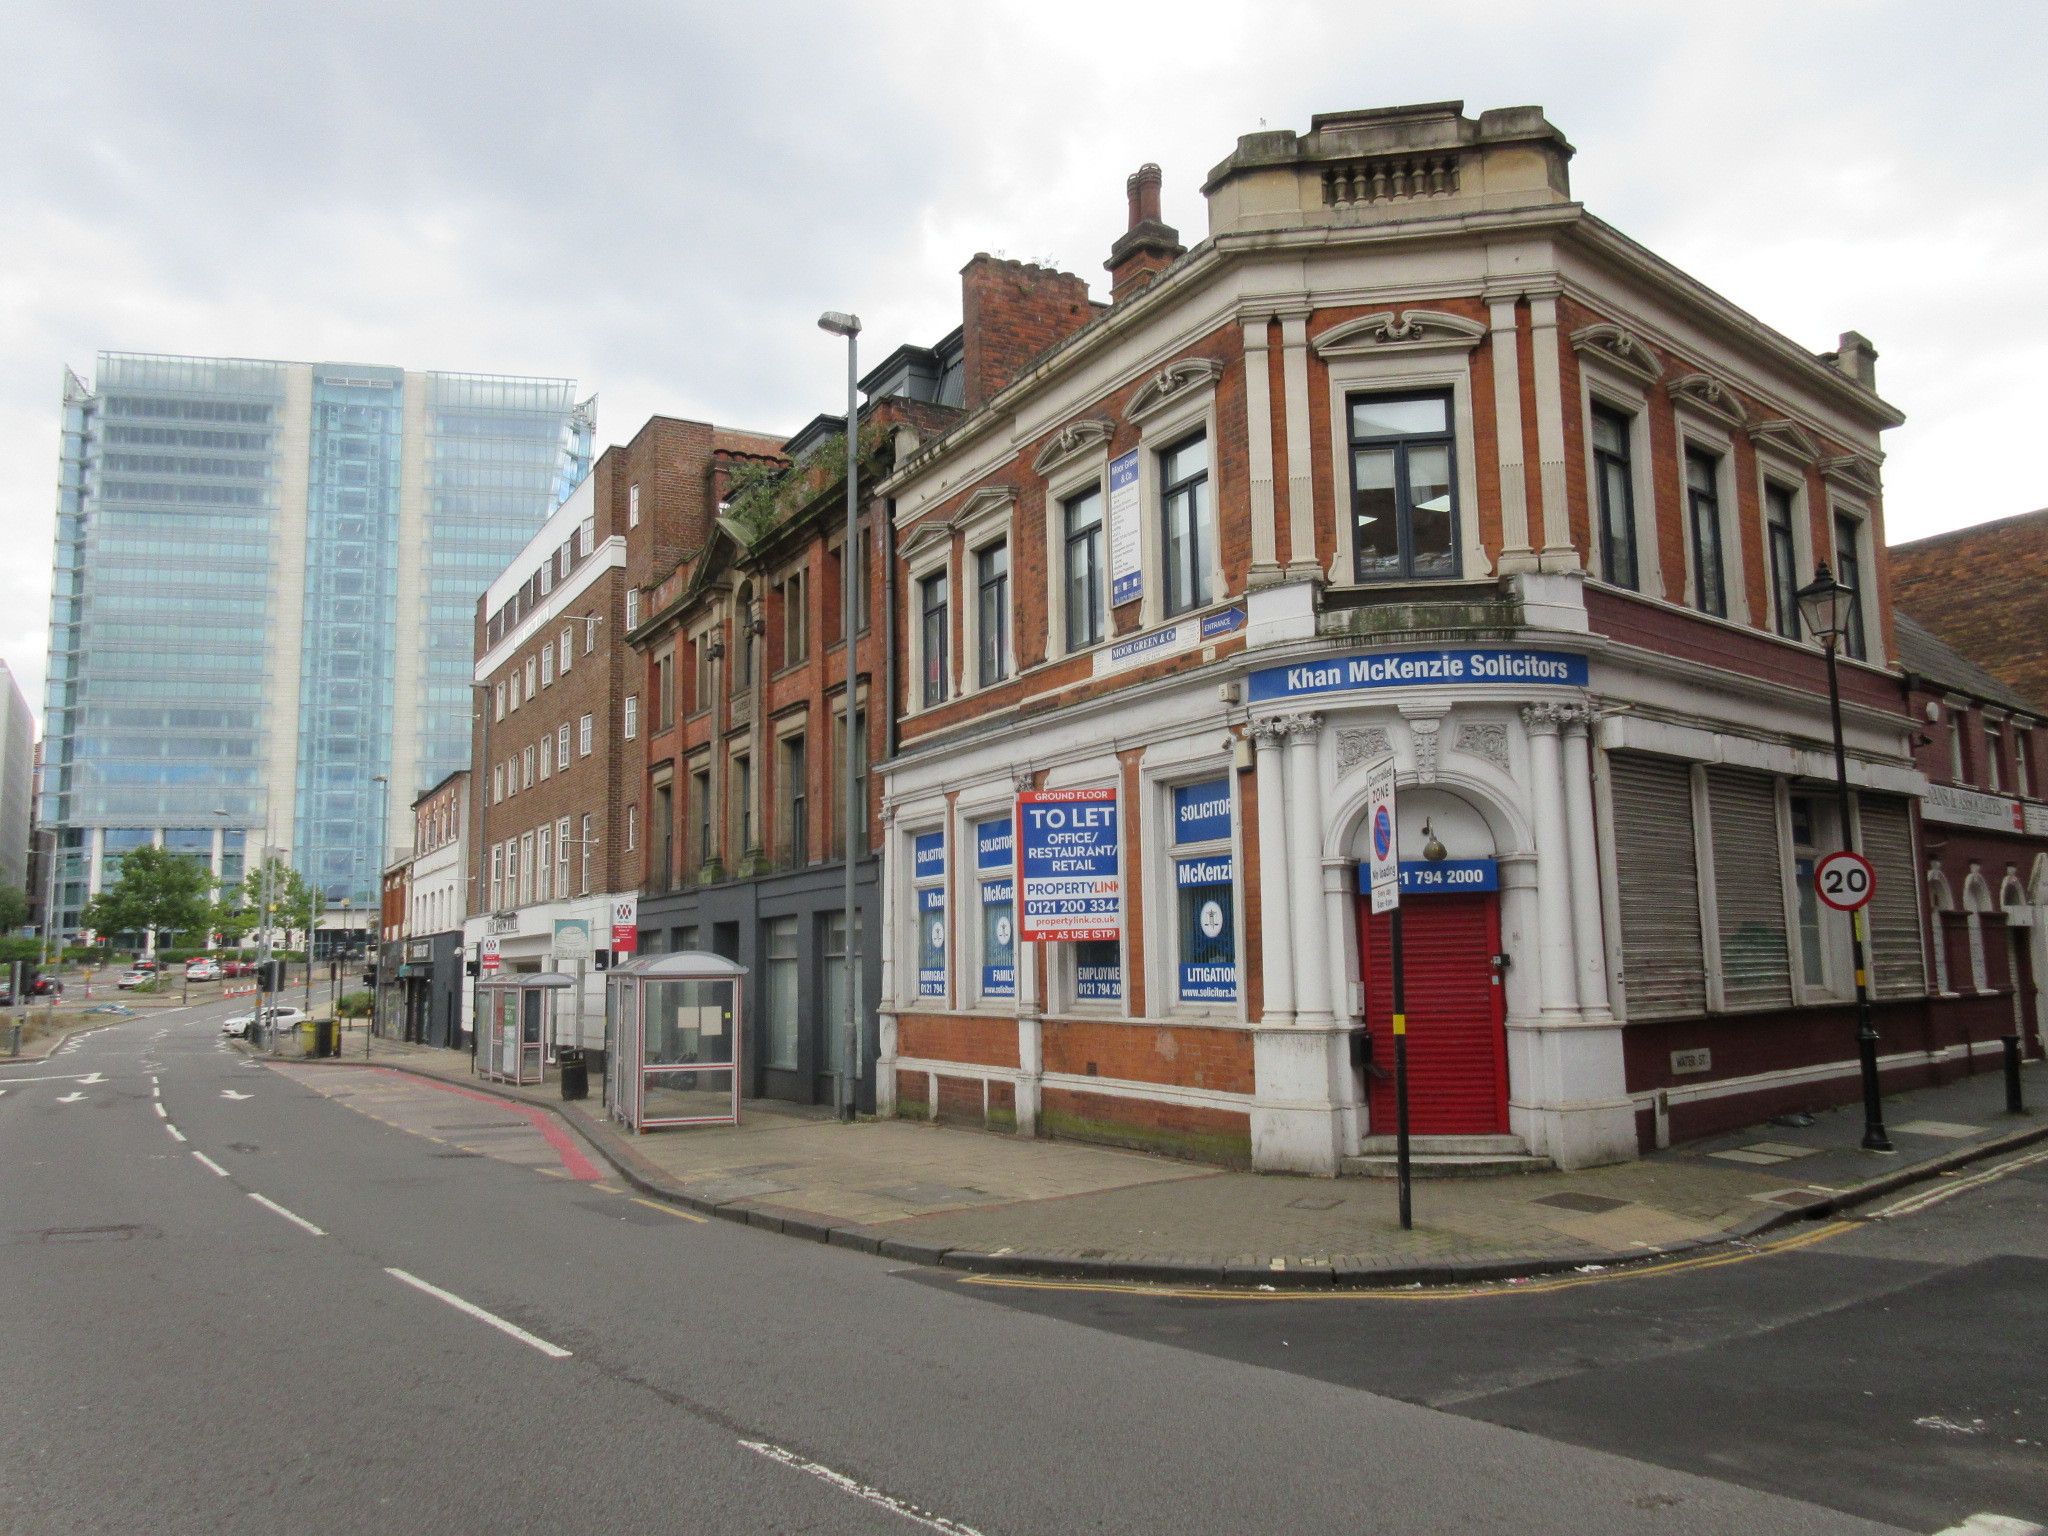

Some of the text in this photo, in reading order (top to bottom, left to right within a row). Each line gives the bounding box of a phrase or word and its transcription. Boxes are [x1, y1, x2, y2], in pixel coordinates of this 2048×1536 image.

[1204, 617, 1232, 632] ENTRANCE
[1112, 644, 1133, 659] MOOR
[1133, 635, 1158, 652] GREEN
[1159, 633, 1166, 643] &
[1288, 654, 1568, 690] Khan McKenzie Solicitors
[1035, 790, 1108, 801] GROUND FLOOR
[1373, 783, 1389, 803] ZONE
[1029, 807, 1115, 829] TO LET
[1047, 831, 1098, 844] OFFICE/
[1028, 844, 1118, 859] RESTAURANT/
[1052, 859, 1096, 872] RETAIL
[1415, 871, 1442, 884] 794
[1446, 869, 1484, 883] 2000
[1825, 868, 1867, 893] 20
[1028, 901, 1056, 914] 0121
[1060, 900, 1085, 913] 200
[1036, 916, 1115, 927] propertylink.co.uk
[1036, 931, 1046, 940] A1
[1056, 930, 1069, 939] A5
[1071, 930, 1089, 939] USE
[1092, 929, 1116, 939] (STP)
[920, 970, 945, 981] IMMIGRA
[1078, 983, 1095, 994] 0121
[1097, 983, 1110, 994] 794
